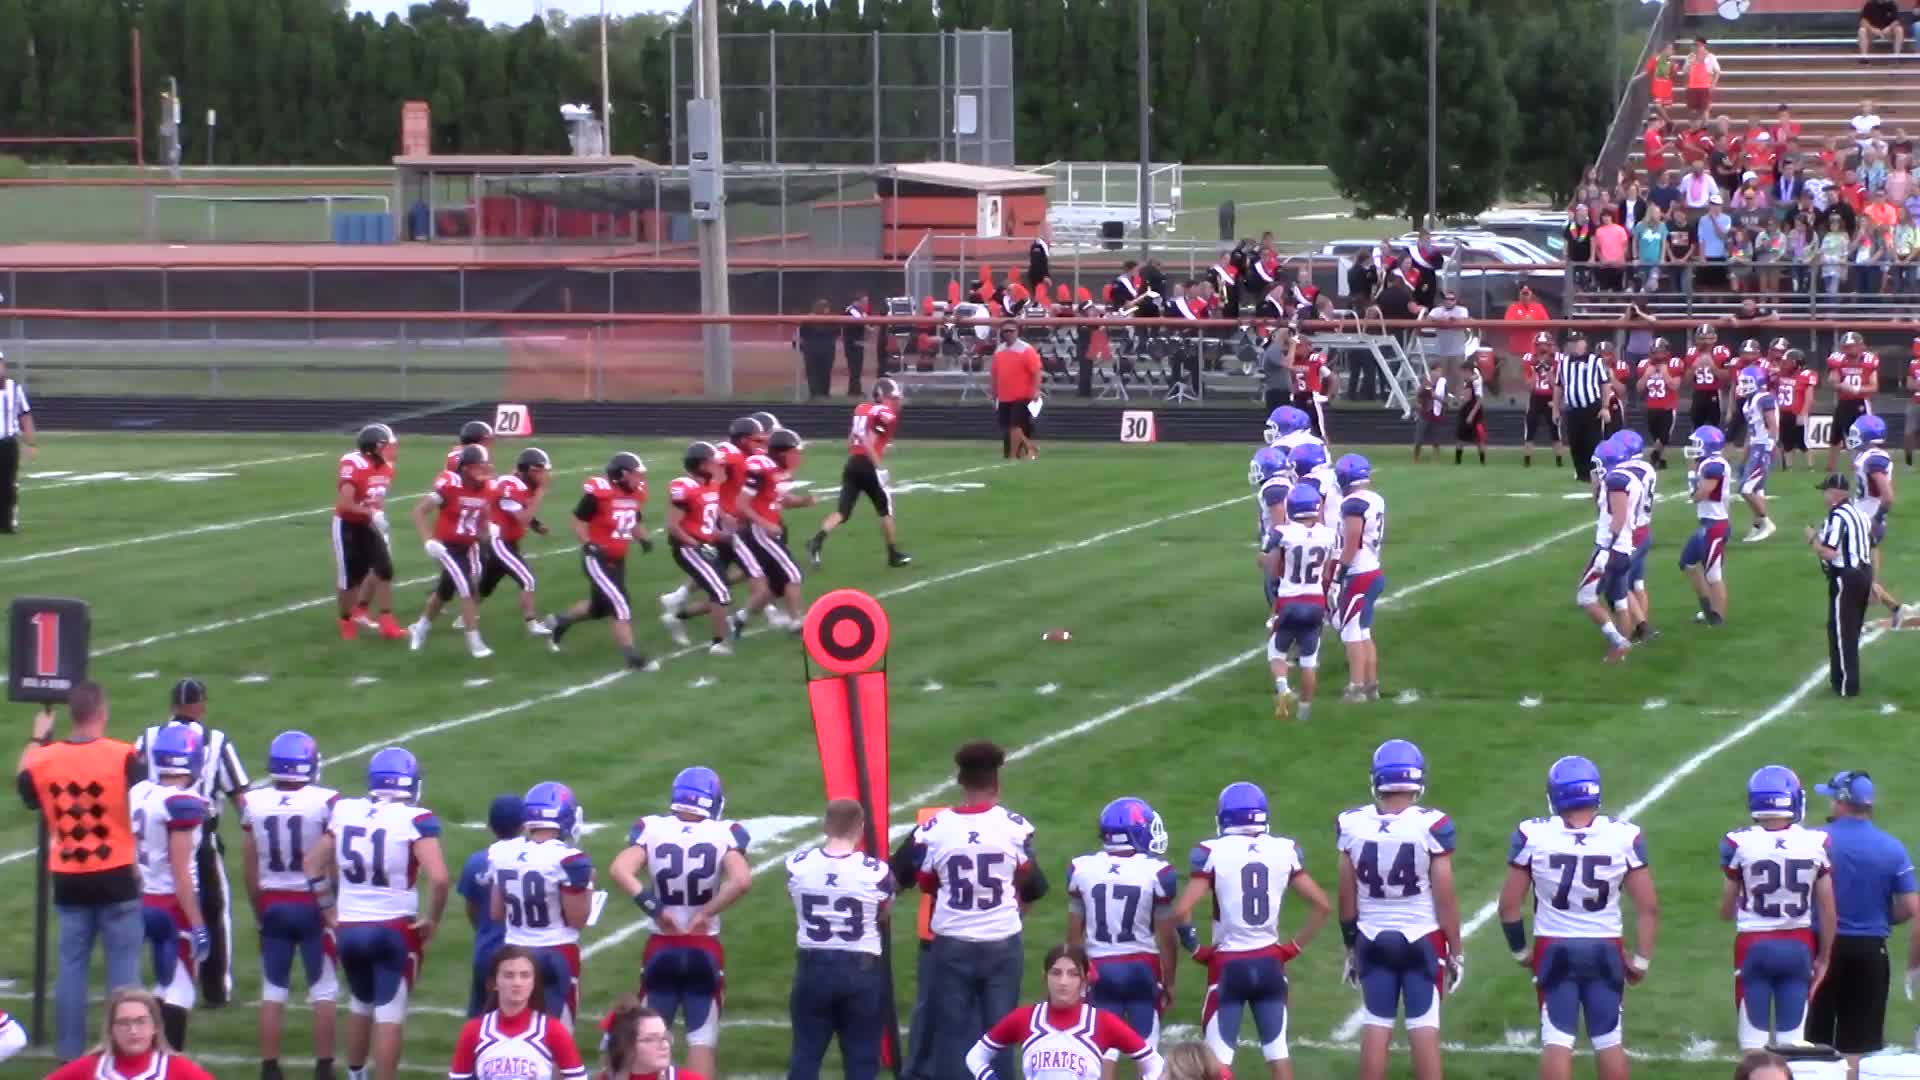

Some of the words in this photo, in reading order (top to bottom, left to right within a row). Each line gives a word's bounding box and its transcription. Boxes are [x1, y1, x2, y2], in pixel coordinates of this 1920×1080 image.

[497, 411, 520, 432] 20
[1124, 417, 1147, 439] 30
[1289, 545, 1326, 584] 12
[31, 611, 60, 676] 1
[263, 815, 304, 872] 11
[342, 825, 389, 887] 51
[1356, 841, 1422, 898] 44
[496, 869, 550, 928] 58
[655, 843, 718, 906] 22
[947, 853, 1005, 911] 65
[1241, 862, 1270, 925] 8
[1549, 854, 1611, 912] 75
[1750, 859, 1814, 917] 25
[802, 893, 864, 942] 53
[1091, 883, 1142, 943] 17
[1031, 1051, 1085, 1077] PIRATES
